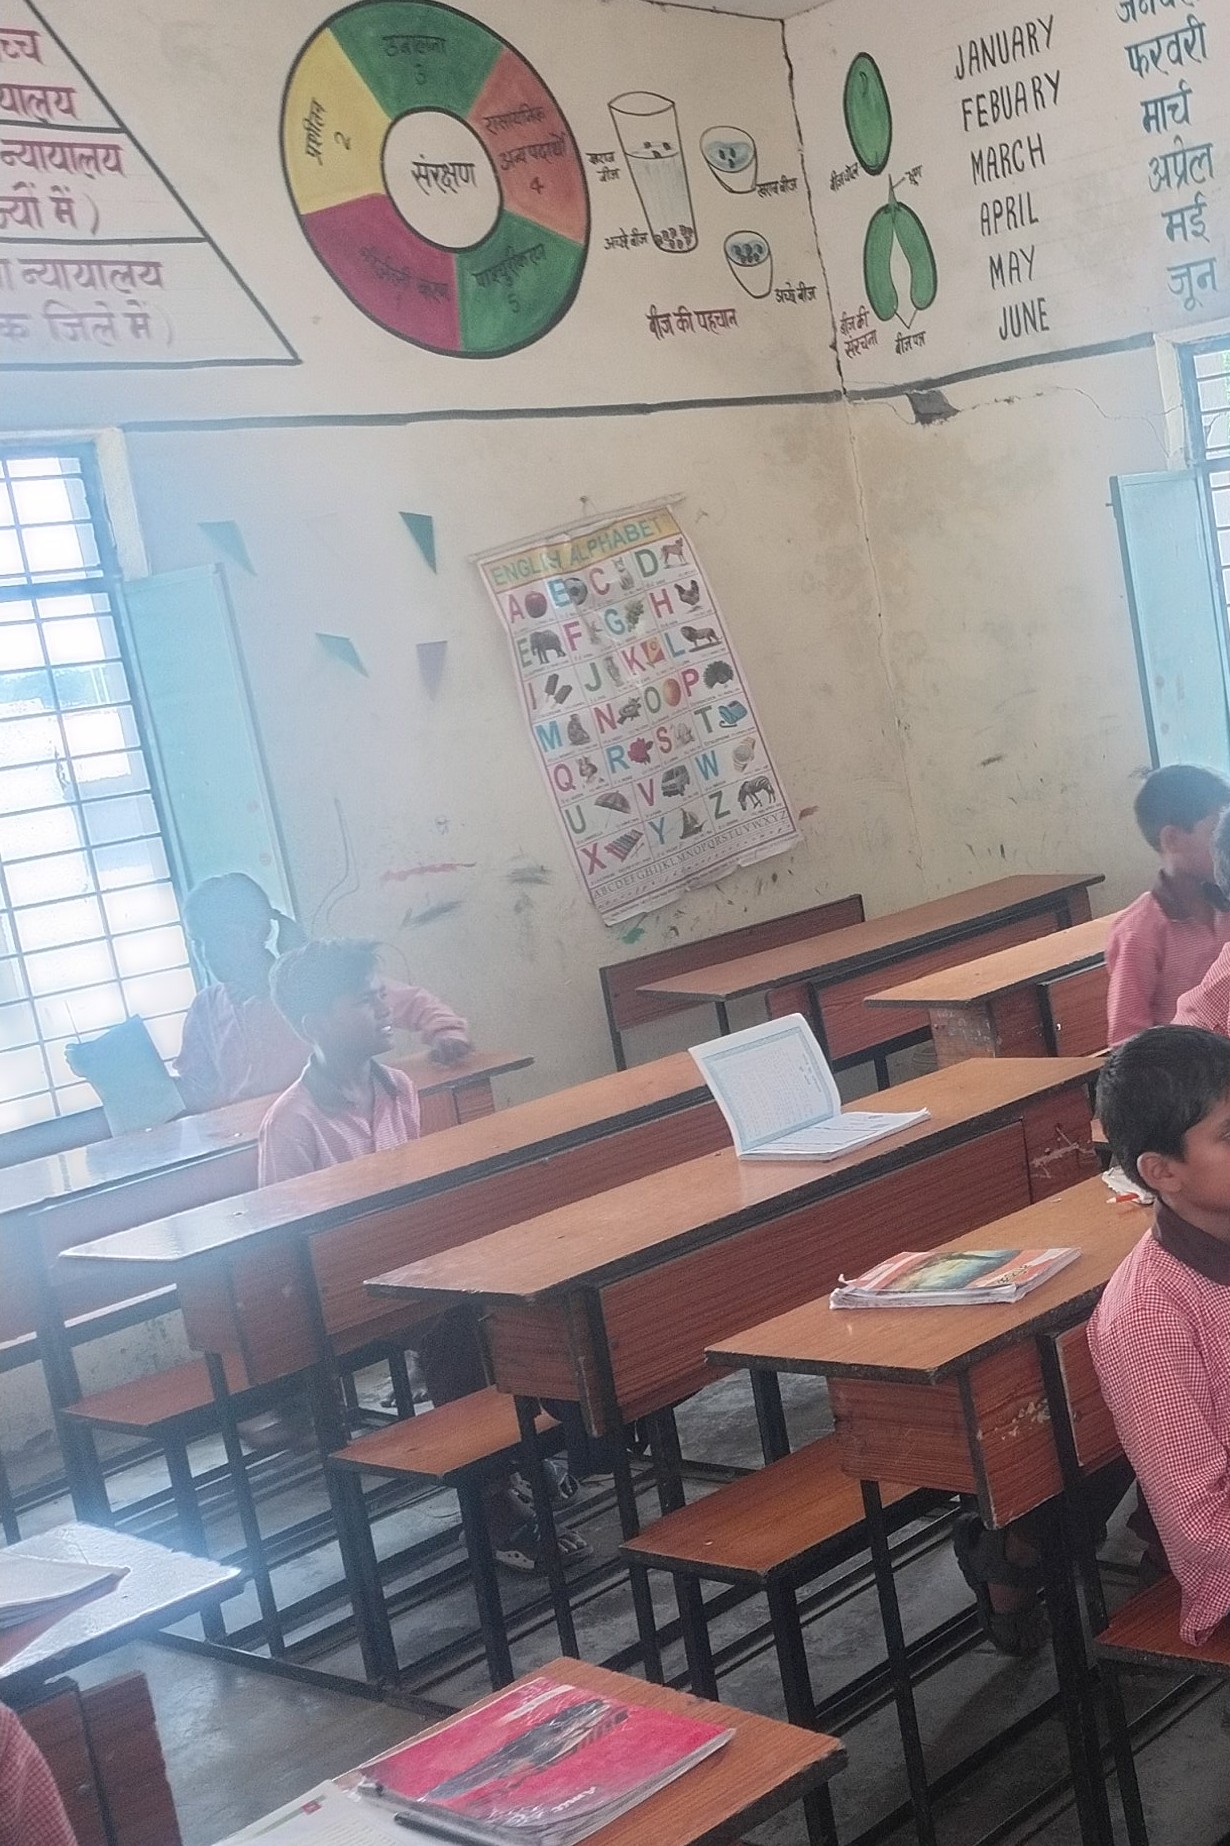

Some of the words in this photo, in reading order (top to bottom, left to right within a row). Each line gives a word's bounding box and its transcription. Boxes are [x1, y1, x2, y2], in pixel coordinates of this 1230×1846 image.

[956, 14, 1053, 80] JANUARY
[1124, 13, 1208, 78] फरवरी
[961, 69, 1060, 132] FEBUARY
[1139, 78, 1193, 134] मार्च
[1, 139, 126, 179] न्यायालय
[970, 132, 1046, 185] MARCH
[411, 153, 478, 196] संरक्षण
[529, 176, 545, 194] 4
[980, 191, 1040, 236] APRIL
[1161, 190, 1210, 242] मई
[18, 258, 164, 294] न्यायालय
[989, 244, 1035, 290] MAY
[1167, 256, 1217, 312] जून
[43, 299, 118, 347] जिले
[646, 304, 673, 339] बीज
[673, 305, 694, 333] की
[694, 307, 738, 335] पहचान
[839, 311, 856, 336] बीज
[856, 305, 870, 329] की
[998, 297, 1050, 340] JUNE
[843, 329, 878, 359] संरचना
[569, 515, 663, 566] ALPHABET
[633, 548, 659, 578] D
[588, 567, 611, 595] C
[508, 593, 525, 623] A
[649, 588, 674, 618] H
[562, 621, 582, 651] F
[604, 608, 625, 635] G
[516, 637, 532, 668] E
[621, 646, 646, 673] K
[663, 632, 686, 658] L
[584, 662, 601, 692] J
[680, 668, 699, 697] P
[527, 682, 537, 710] I
[643, 686, 661, 714] O
[593, 703, 618, 734] N
[693, 705, 713, 734] T
[535, 720, 563, 752] M
[655, 726, 673, 754] S
[605, 744, 630, 774] R
[695, 750, 720, 781] W
[553, 763, 576, 792] Q
[637, 778, 655, 806] V
[565, 805, 587, 834] U
[709, 790, 731, 820] Z
[648, 817, 665, 845] Y
[580, 842, 607, 875] X
